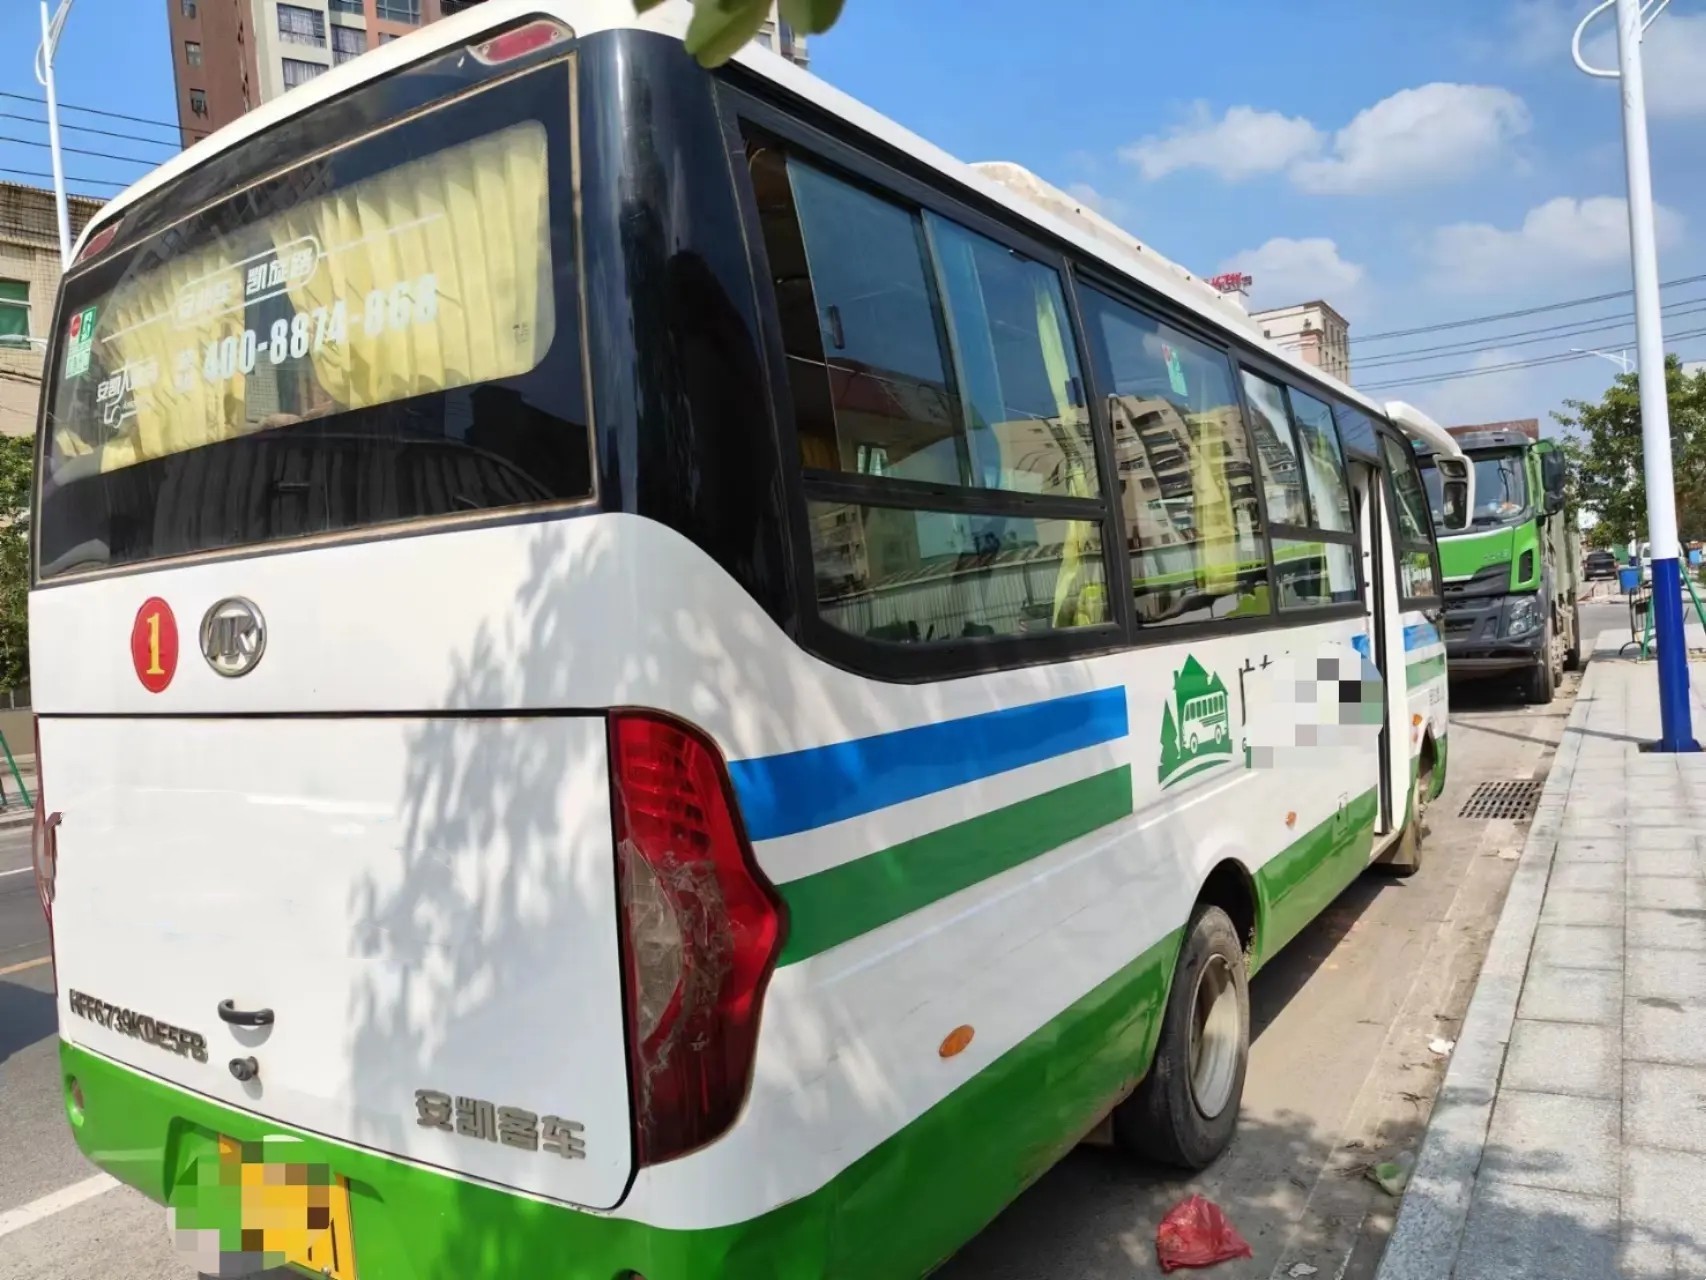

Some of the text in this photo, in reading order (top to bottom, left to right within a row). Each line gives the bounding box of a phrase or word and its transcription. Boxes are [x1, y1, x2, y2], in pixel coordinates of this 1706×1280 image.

[203, 273, 438, 383] 400-8874-868
[146, 612, 165, 675] 1
[415, 1088, 586, 1159] 安凯客车
